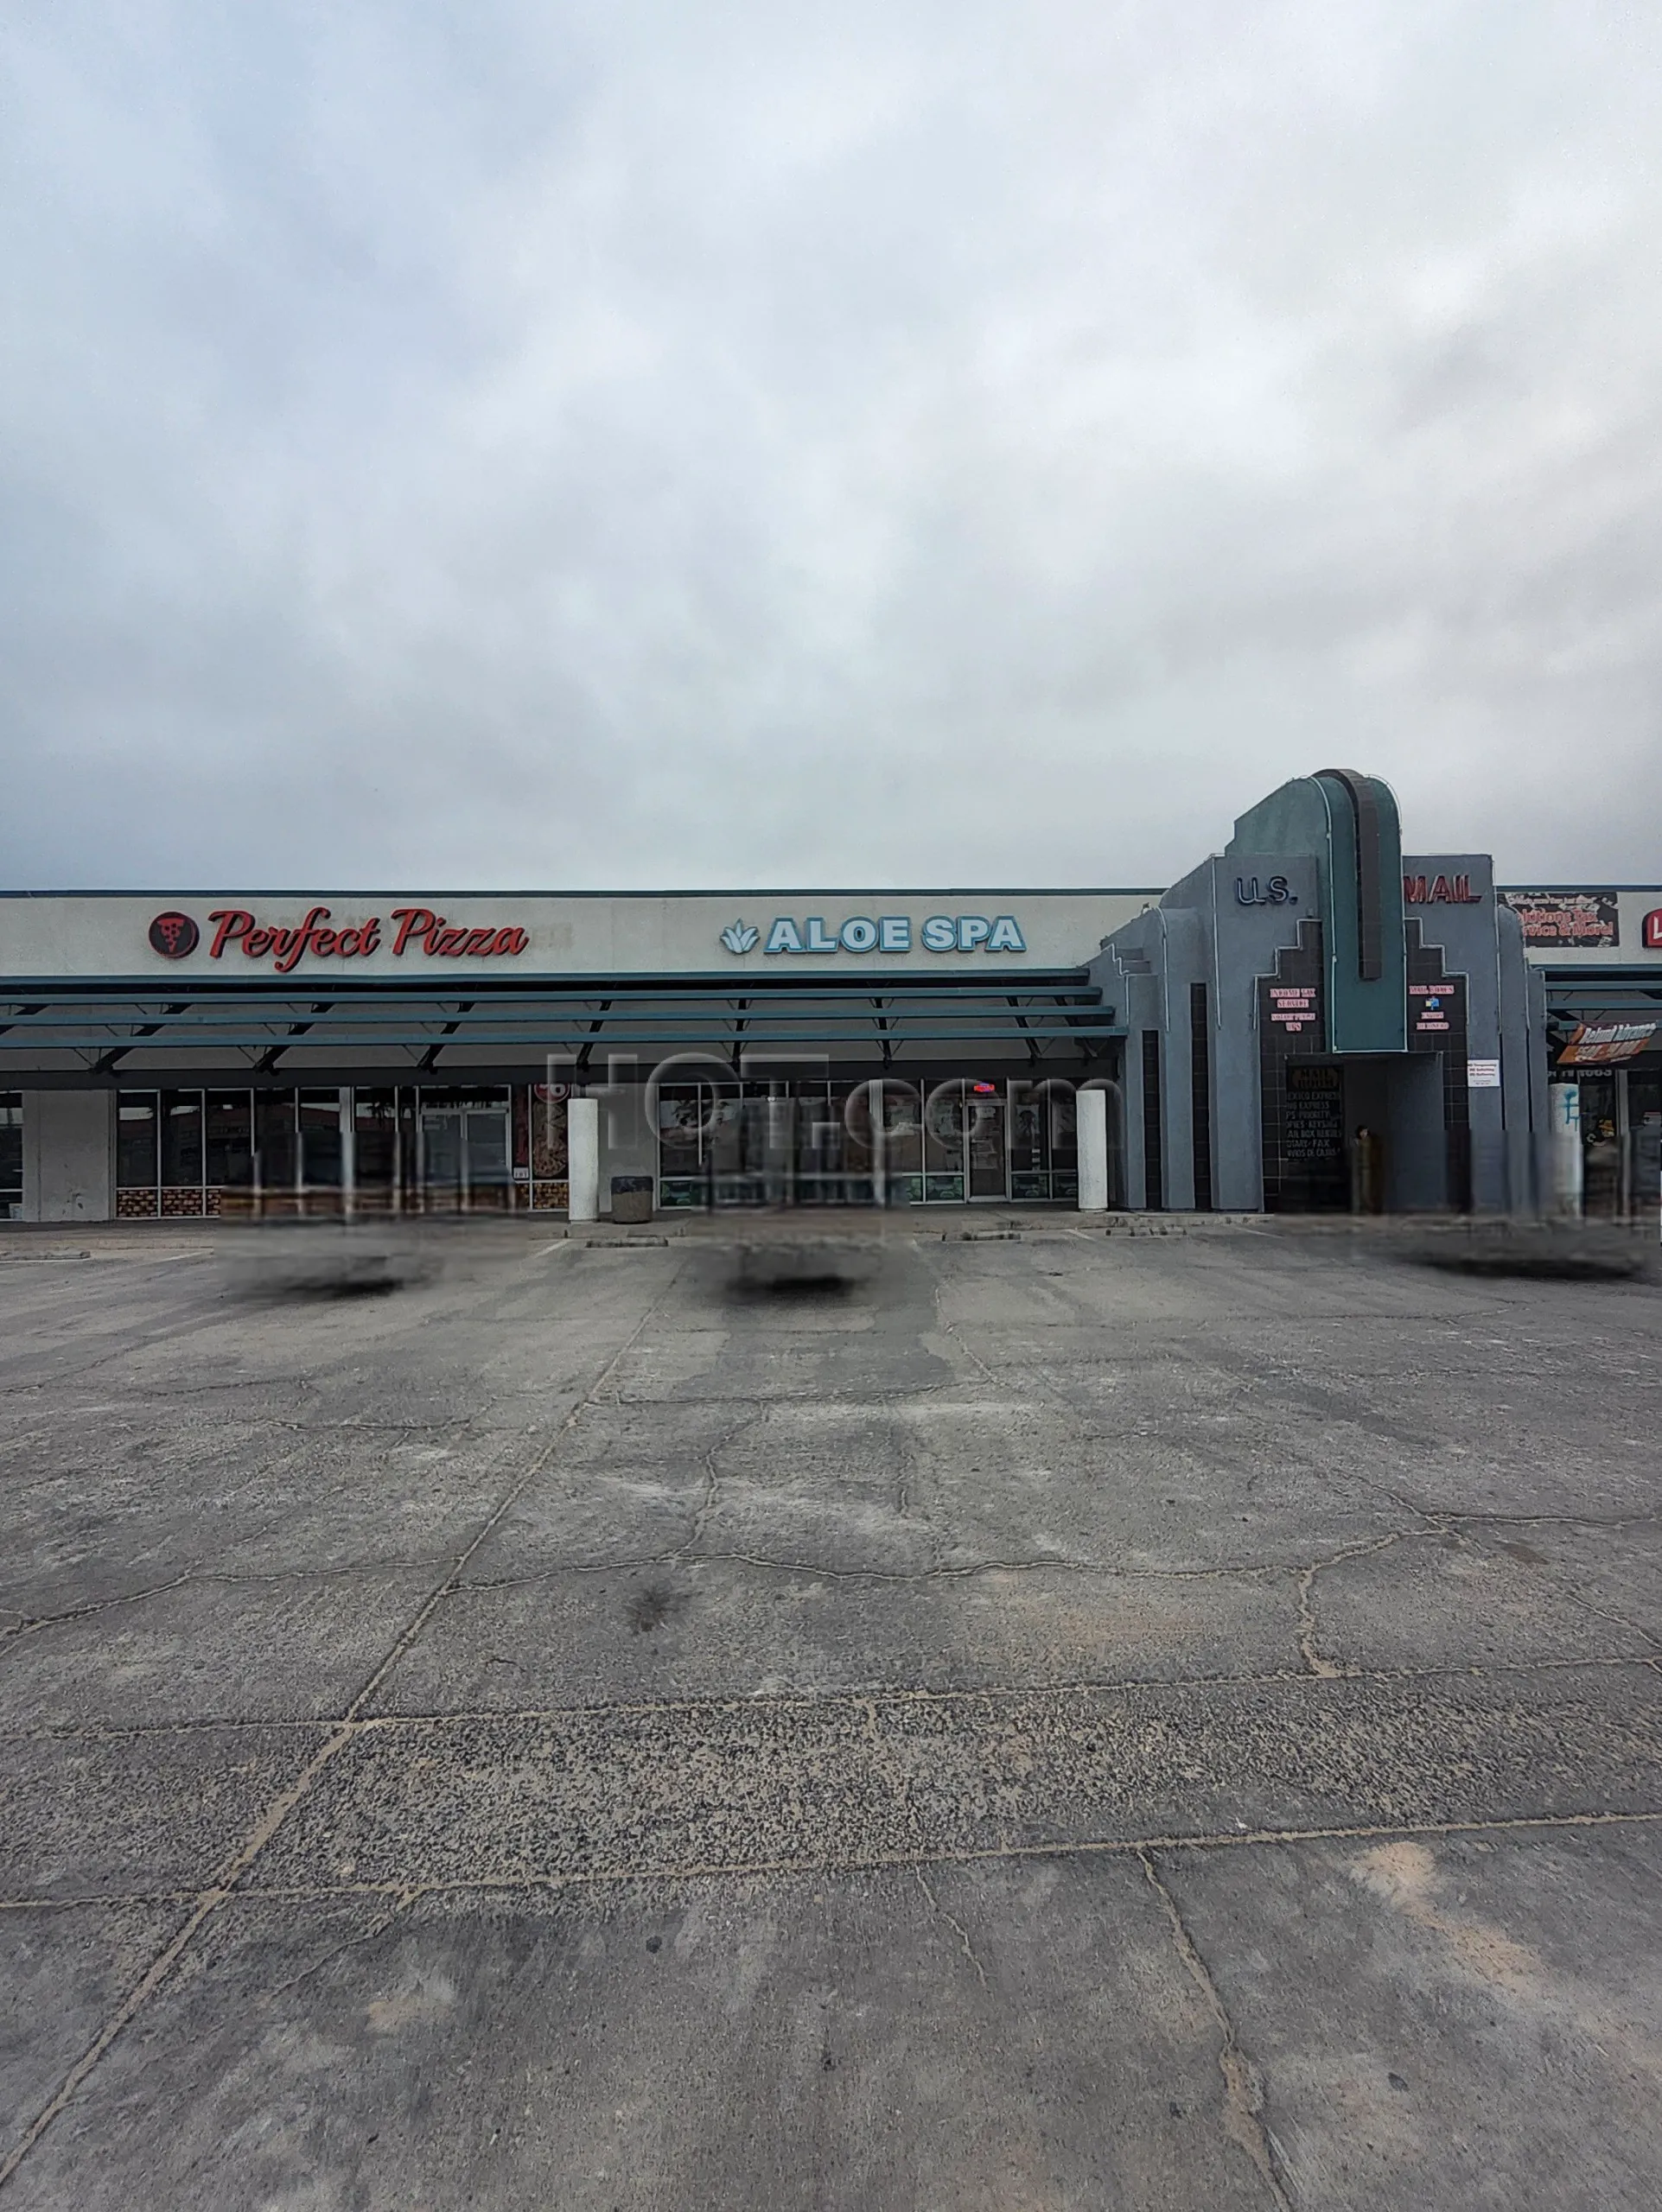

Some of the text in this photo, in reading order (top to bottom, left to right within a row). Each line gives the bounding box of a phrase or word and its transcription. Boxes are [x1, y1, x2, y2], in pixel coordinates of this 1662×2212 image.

[1236, 875, 1482, 906] U.S. MAIL
[207, 906, 381, 973] Perfect
[391, 908, 530, 957] Pizza
[764, 915, 1027, 953] ALOE SPA
[1522, 924, 1557, 937] rvice
